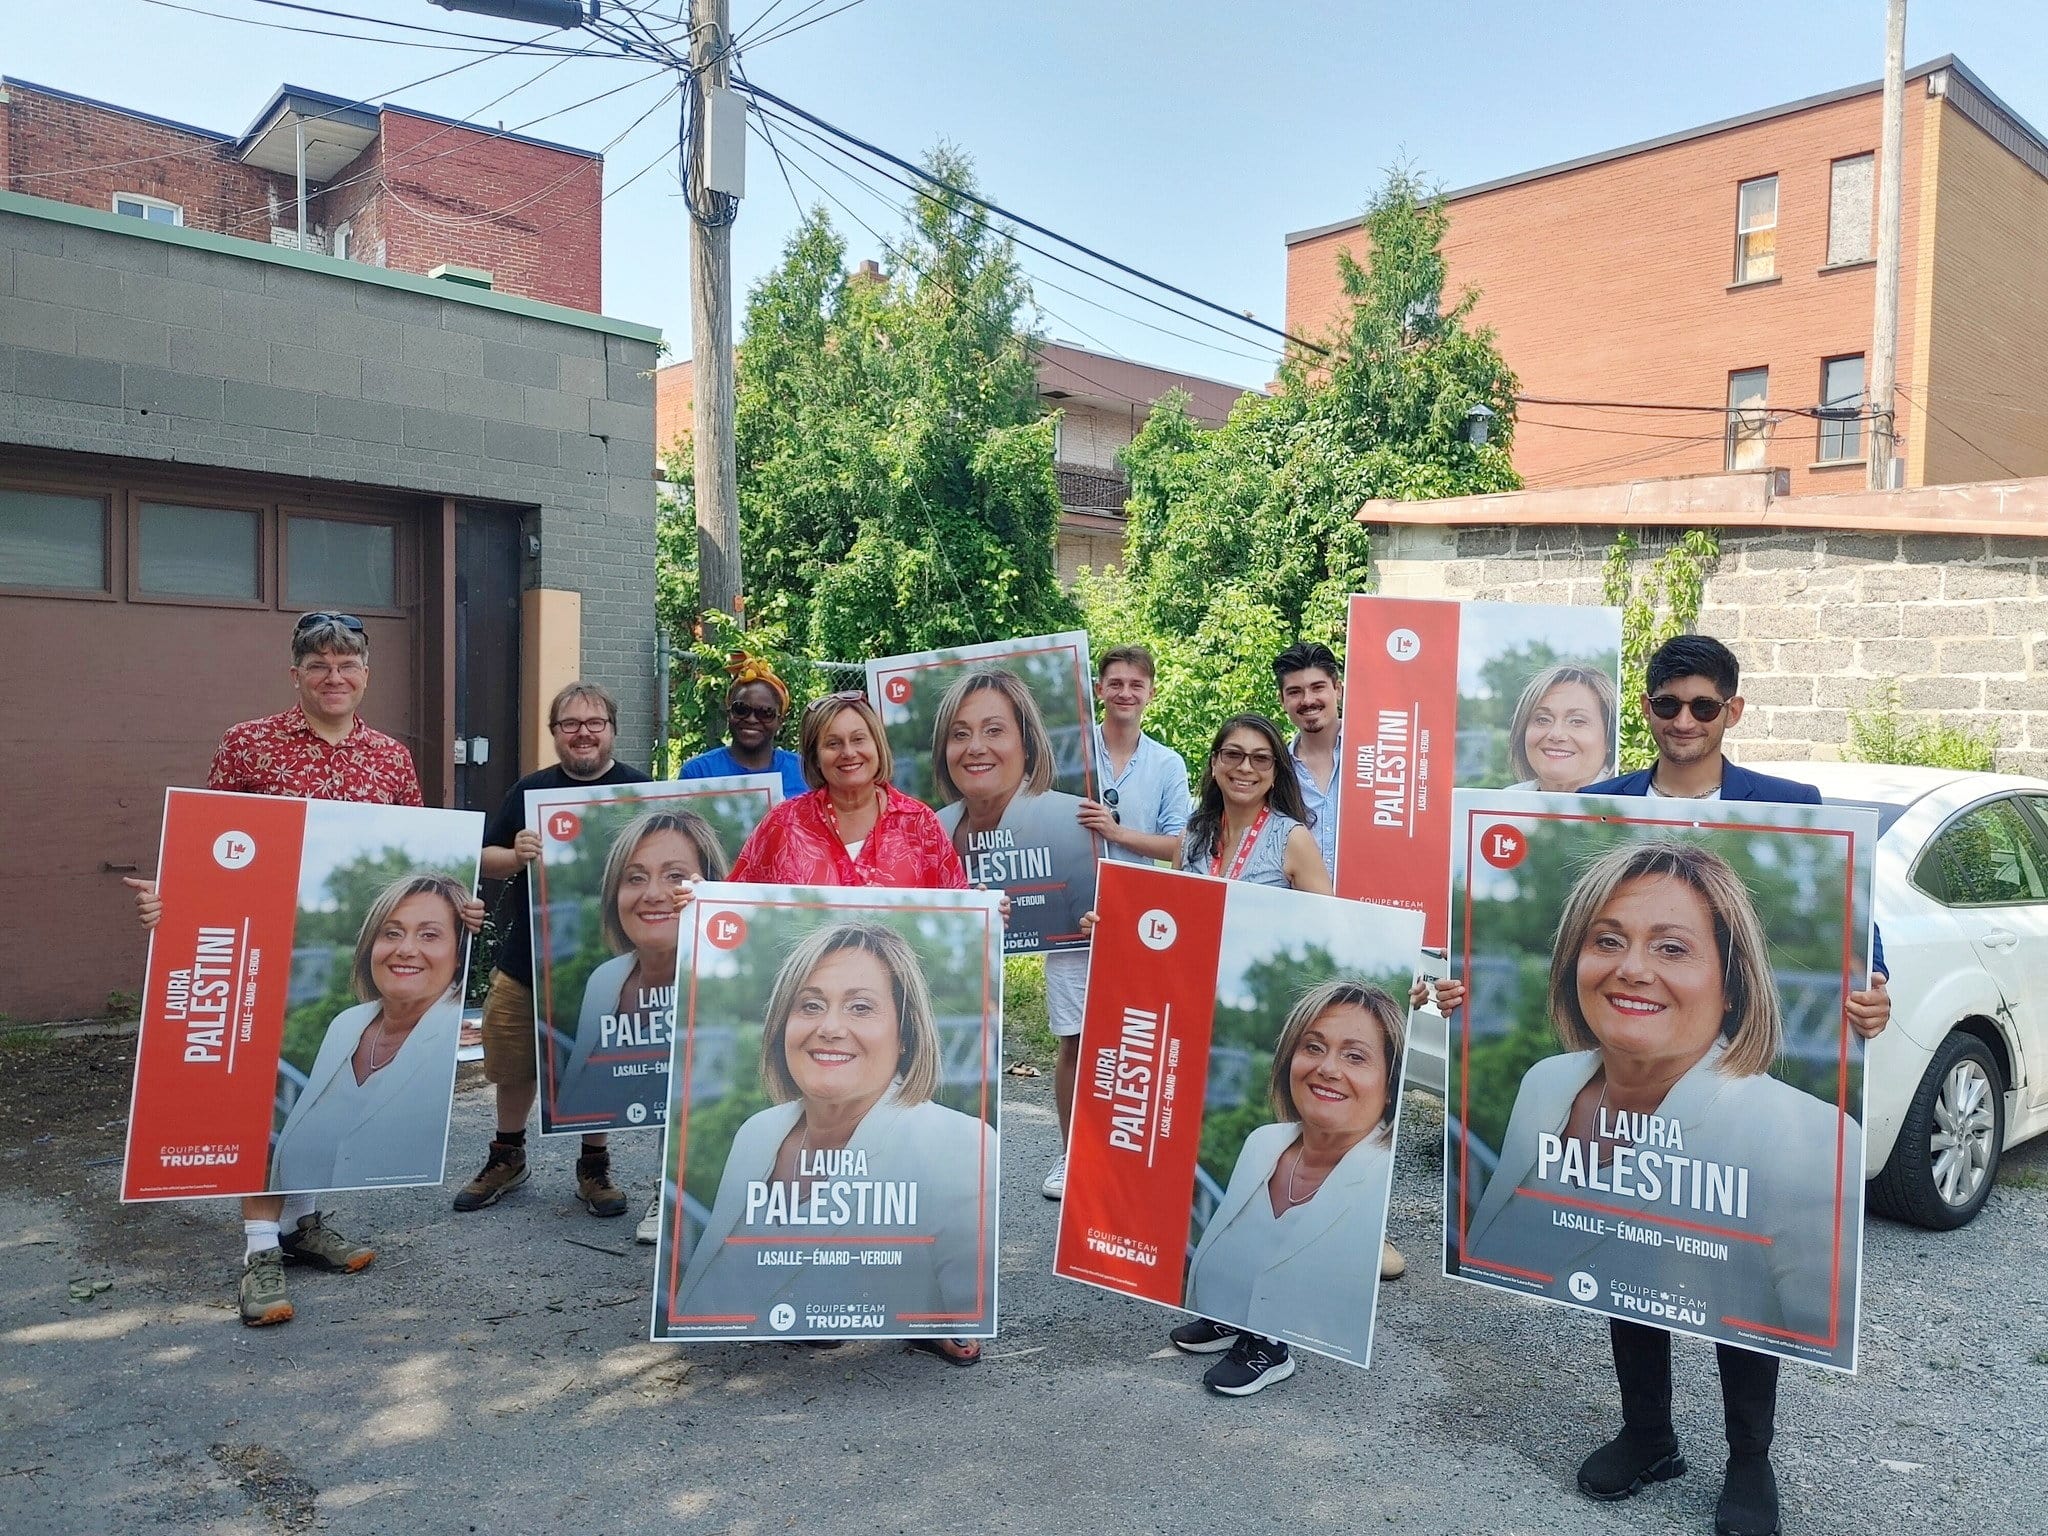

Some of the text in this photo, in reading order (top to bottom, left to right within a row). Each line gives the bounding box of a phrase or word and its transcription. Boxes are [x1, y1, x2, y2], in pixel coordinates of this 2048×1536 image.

[1356, 744, 1376, 788] LAURA
[1373, 709, 1408, 827] PALESTINI
[968, 829, 1015, 852] LAURA
[965, 847, 1052, 884] LESTINI
[1400, 900, 1424, 909] TEAM
[1004, 938, 1039, 949] UDEAU
[165, 968, 191, 1020] LAURA
[184, 927, 236, 1062] PALESTINI
[639, 986, 676, 1009] LAU
[600, 1010, 675, 1048] PALES
[1093, 1047, 1118, 1101] LAURA
[1109, 1006, 1158, 1152] PALESTINI
[1600, 1106, 1684, 1151] LAURA
[160, 1144, 240, 1155] ÉQUIPE TEAM
[160, 1153, 239, 1167] TRUDEAU
[800, 1149, 868, 1176] LAURA
[1537, 1132, 1749, 1219] PALESTINI
[745, 1181, 918, 1226] PALESTINI
[1087, 1226, 1158, 1254] ÉQUIPE TEAM
[1087, 1237, 1157, 1266] TRUDEAU
[805, 1303, 886, 1313] ÉQUIPE TEAM
[1610, 1279, 1707, 1310] ÉQUIPE TEAM
[1610, 1292, 1706, 1326] TRUDEAU
[805, 1315, 885, 1328] TRUDEAU
